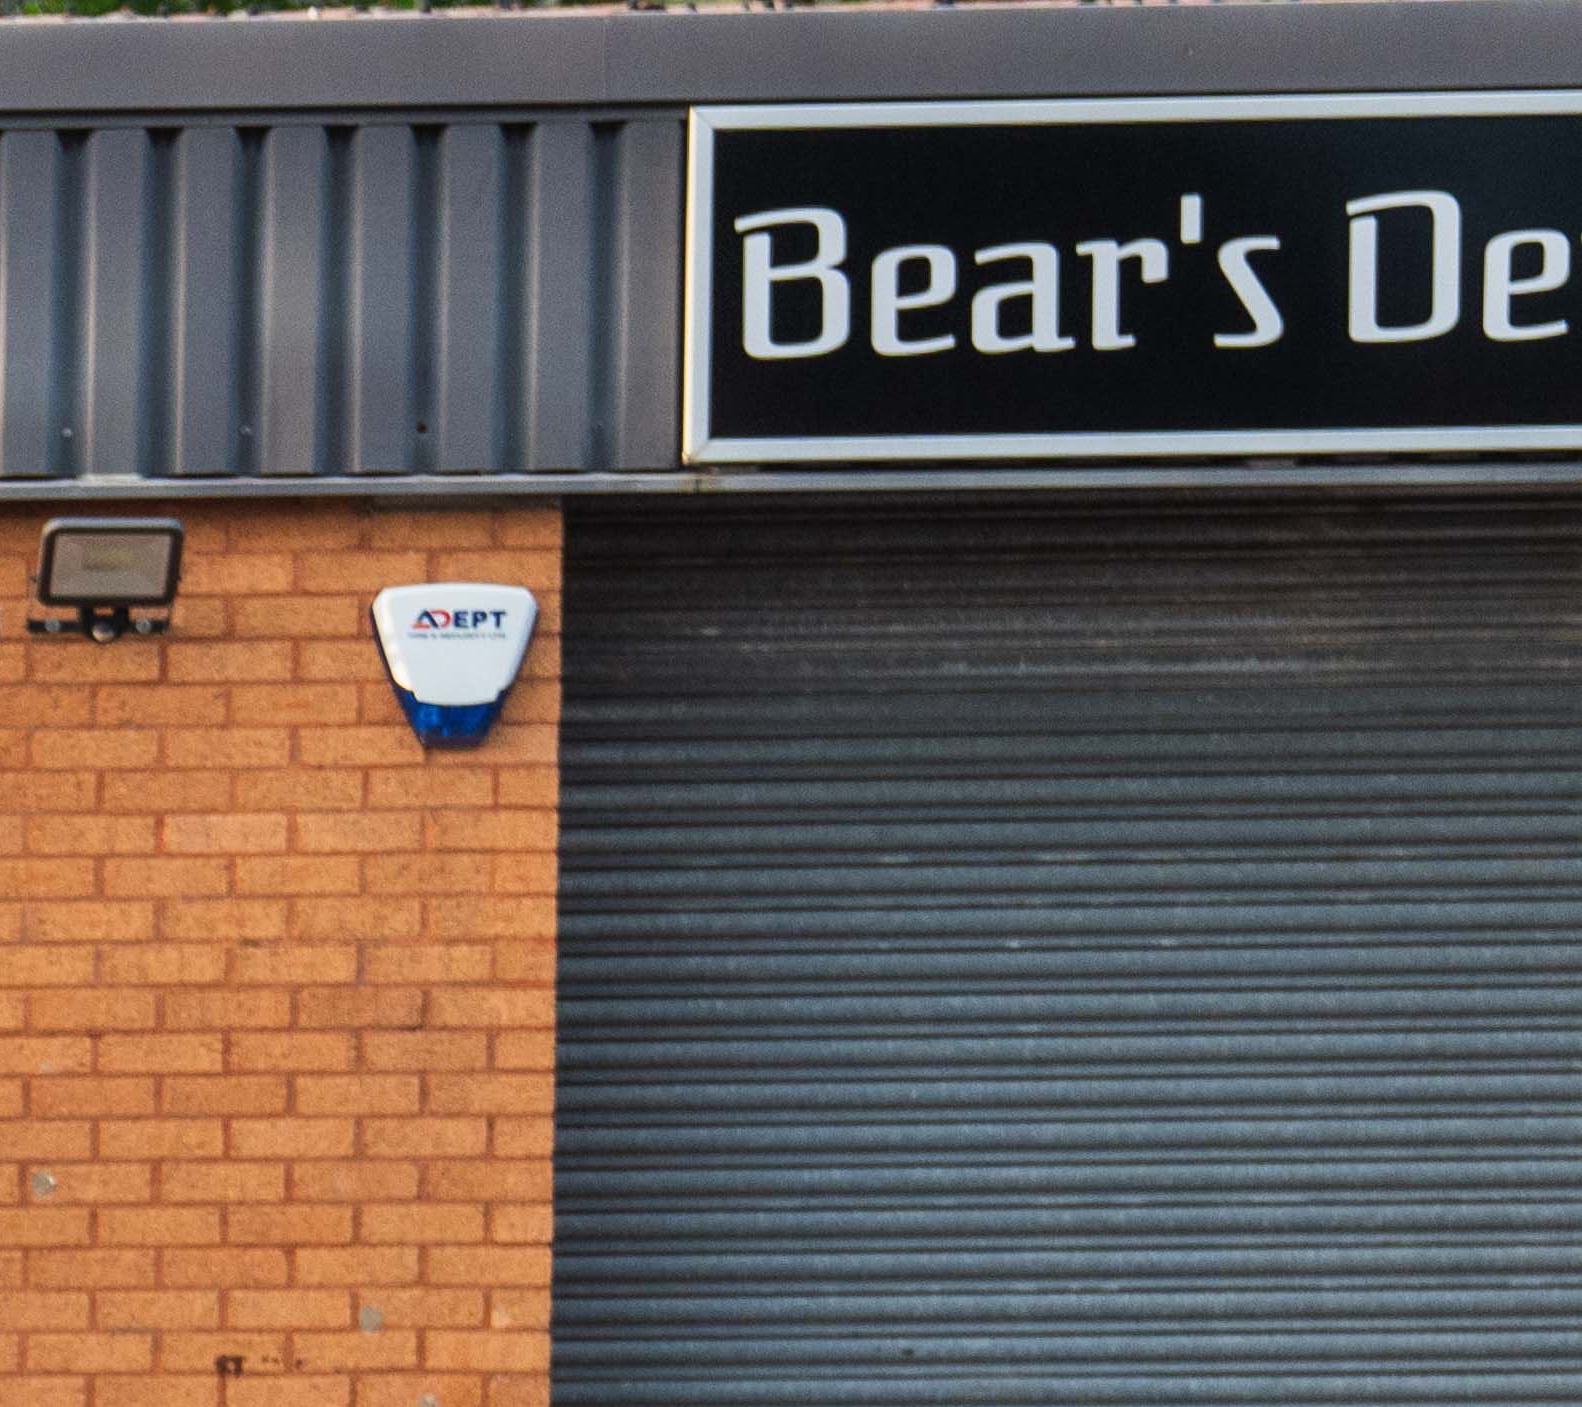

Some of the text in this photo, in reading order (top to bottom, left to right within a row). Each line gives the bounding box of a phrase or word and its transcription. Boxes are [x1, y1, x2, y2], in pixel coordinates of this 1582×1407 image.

[733, 190, 1582, 360] Bear's De
[412, 609, 508, 629] ADEPT
